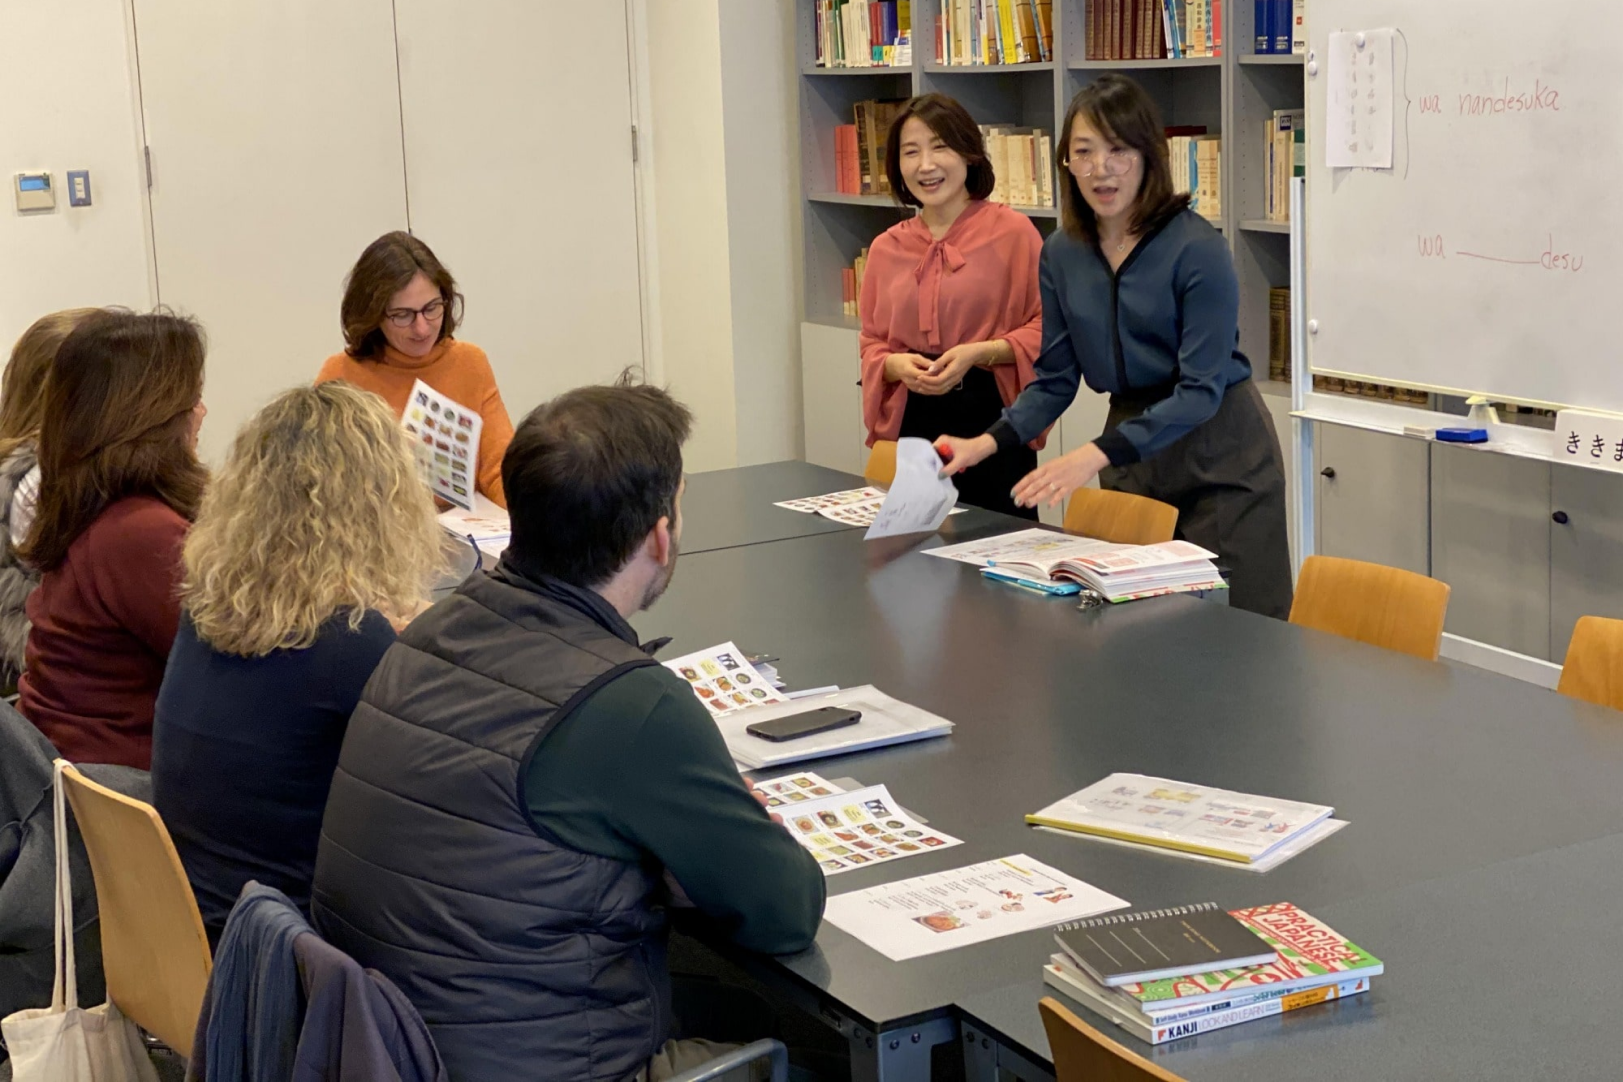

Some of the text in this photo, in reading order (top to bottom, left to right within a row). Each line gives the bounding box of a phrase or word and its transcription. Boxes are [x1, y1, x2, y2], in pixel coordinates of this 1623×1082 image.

[1419, 76, 1560, 115] wa nandesuka
[1418, 233, 1584, 272] wa desu
[1262, 917, 1341, 967] JAPANESE
[1279, 911, 1367, 964] PRACTICAL
[1168, 1021, 1198, 1039] KANJI
[1200, 1013, 1223, 1031] LOOK
[1222, 1010, 1238, 1026] AND
[1239, 1004, 1265, 1021] LEARN
